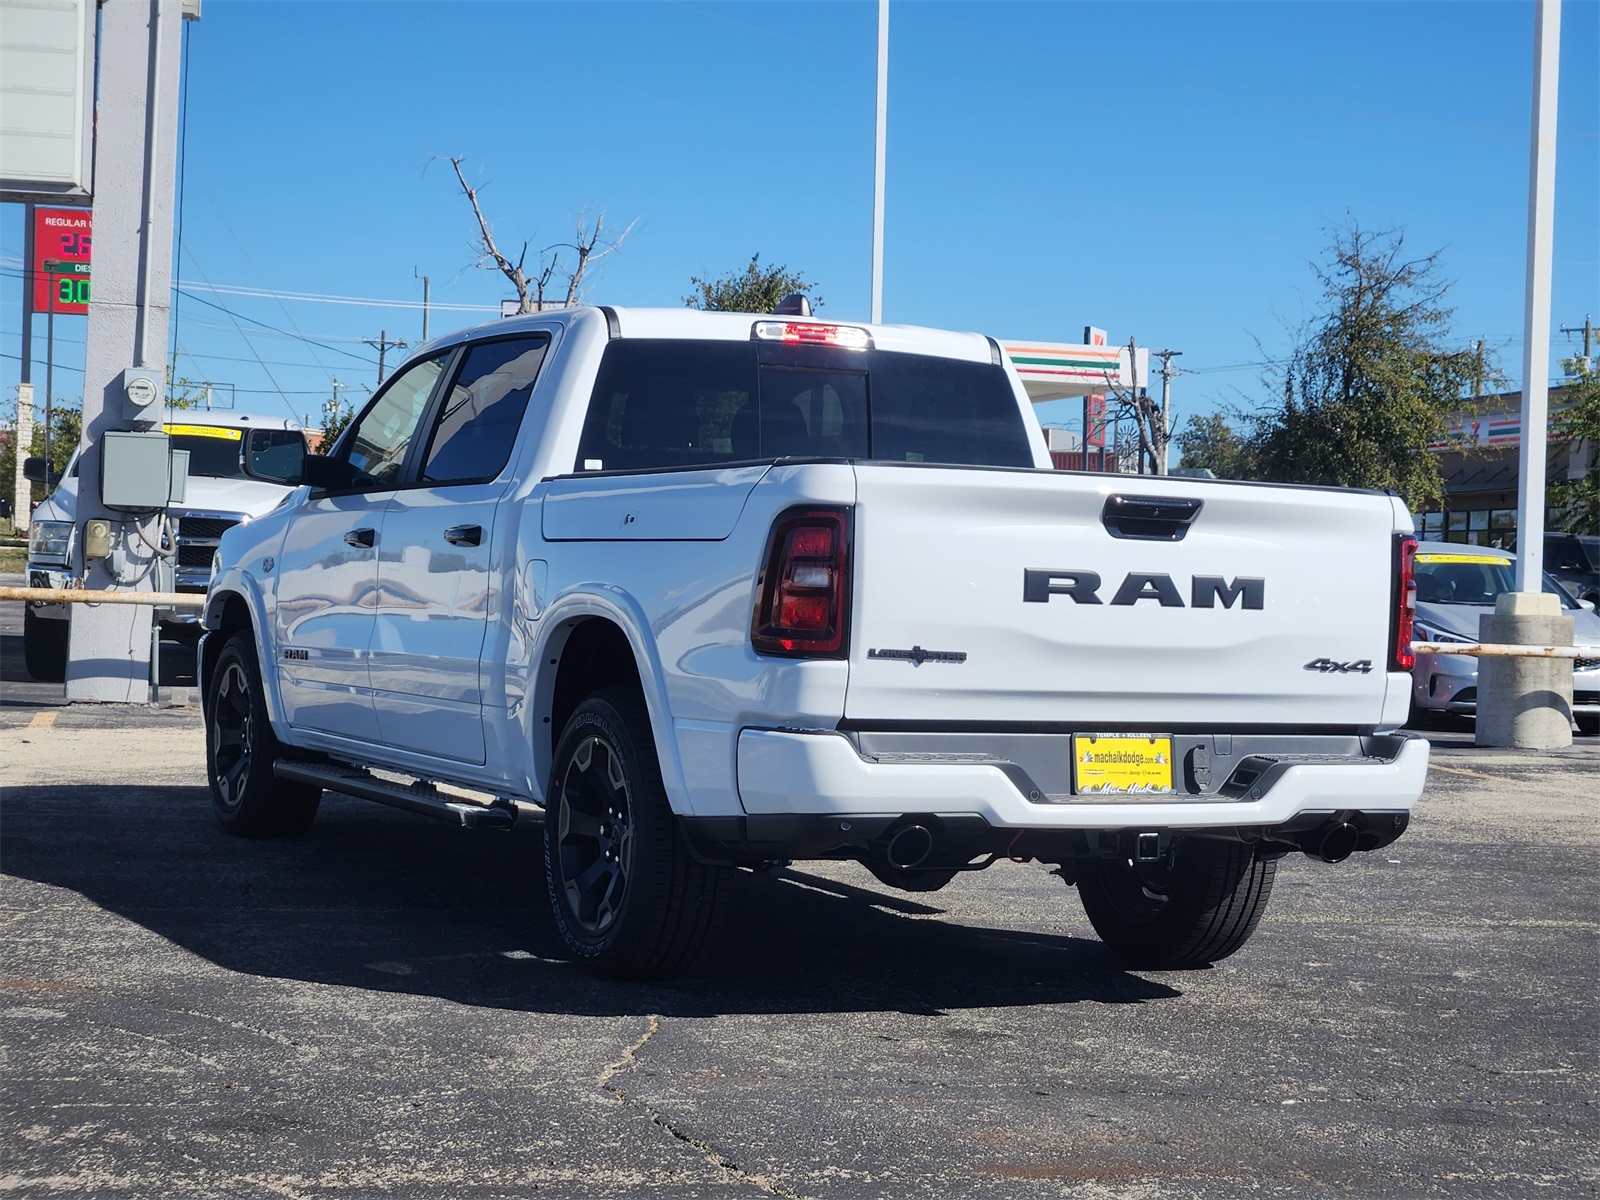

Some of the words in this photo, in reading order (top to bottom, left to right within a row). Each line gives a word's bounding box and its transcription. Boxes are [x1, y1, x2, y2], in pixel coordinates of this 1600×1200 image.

[45, 217, 86, 227] REGULAR
[59, 278, 90, 304] 3.0
[1023, 567, 1265, 610] RAM
[284, 649, 309, 660] RAM
[867, 648, 911, 659] LONE
[926, 650, 967, 661] STAR
[1094, 751, 1154, 766] machaikdodge.com
[1101, 782, 1122, 794] Mac
[1127, 782, 1154, 794] Haik
